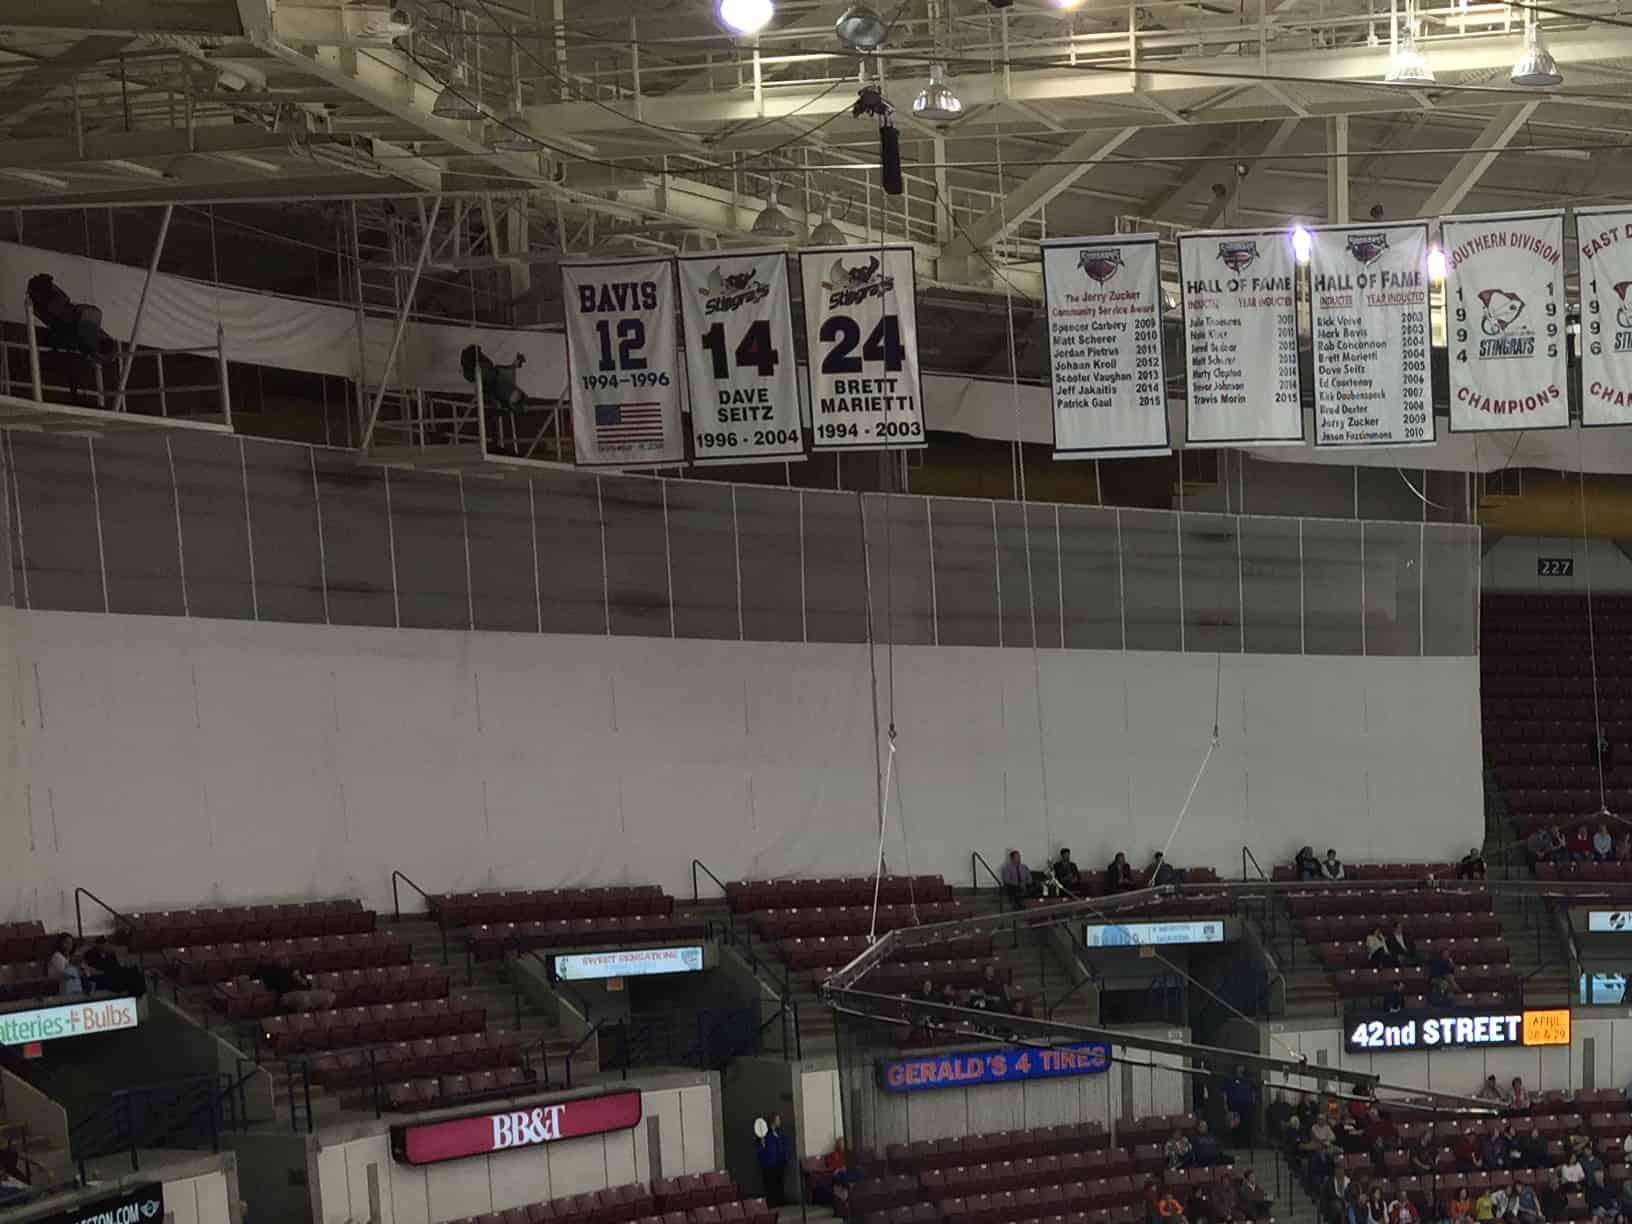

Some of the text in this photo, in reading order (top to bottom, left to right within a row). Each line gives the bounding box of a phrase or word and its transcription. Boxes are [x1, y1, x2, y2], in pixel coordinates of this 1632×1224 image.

[1449, 231, 1561, 271] SOUTHERN DIVISION
[1581, 227, 1619, 260] EAST
[1187, 276, 1291, 294] HALL OF FAME
[1314, 270, 1422, 292] HALL OF FAME
[578, 281, 658, 313] BAVIS
[1081, 291, 1106, 304] Jerry
[1108, 289, 1140, 301] Zucker
[596, 318, 648, 371] 12
[819, 315, 906, 375] 24
[1135, 331, 1158, 342] 2010
[702, 320, 780, 379] 14
[1136, 344, 1157, 355] 2011
[1402, 349, 1425, 360] 2004
[1136, 357, 1159, 368] 2012
[1402, 361, 1426, 372] 2005
[1093, 372, 1132, 383] Vaughan
[1137, 370, 1159, 381] 2013
[834, 379, 898, 396] BRETT
[1056, 383, 1159, 397] Jeff Jakaitis 2014
[1402, 387, 1425, 398] 2007
[719, 389, 769, 405] DAVE
[820, 396, 916, 414] MARIETTI
[1057, 398, 1089, 410] Patrick
[1139, 396, 1161, 407] 2015
[1194, 392, 1298, 405] Travis Morin 2015
[1457, 384, 1560, 416] CHAMPIONS
[717, 406, 775, 423] SEITZ
[1348, 413, 1427, 428] Zucker 2009
[696, 425, 800, 448] 1996 2004
[816, 421, 922, 443] 1994 2003
[1541, 561, 1571, 575] 227
[1351, 1020, 1416, 1047] 42nd
[1423, 1015, 1522, 1045] STREET
[888, 1047, 1105, 1087] GERALD'S 4 TIRES
[492, 1104, 566, 1150] BB&T
